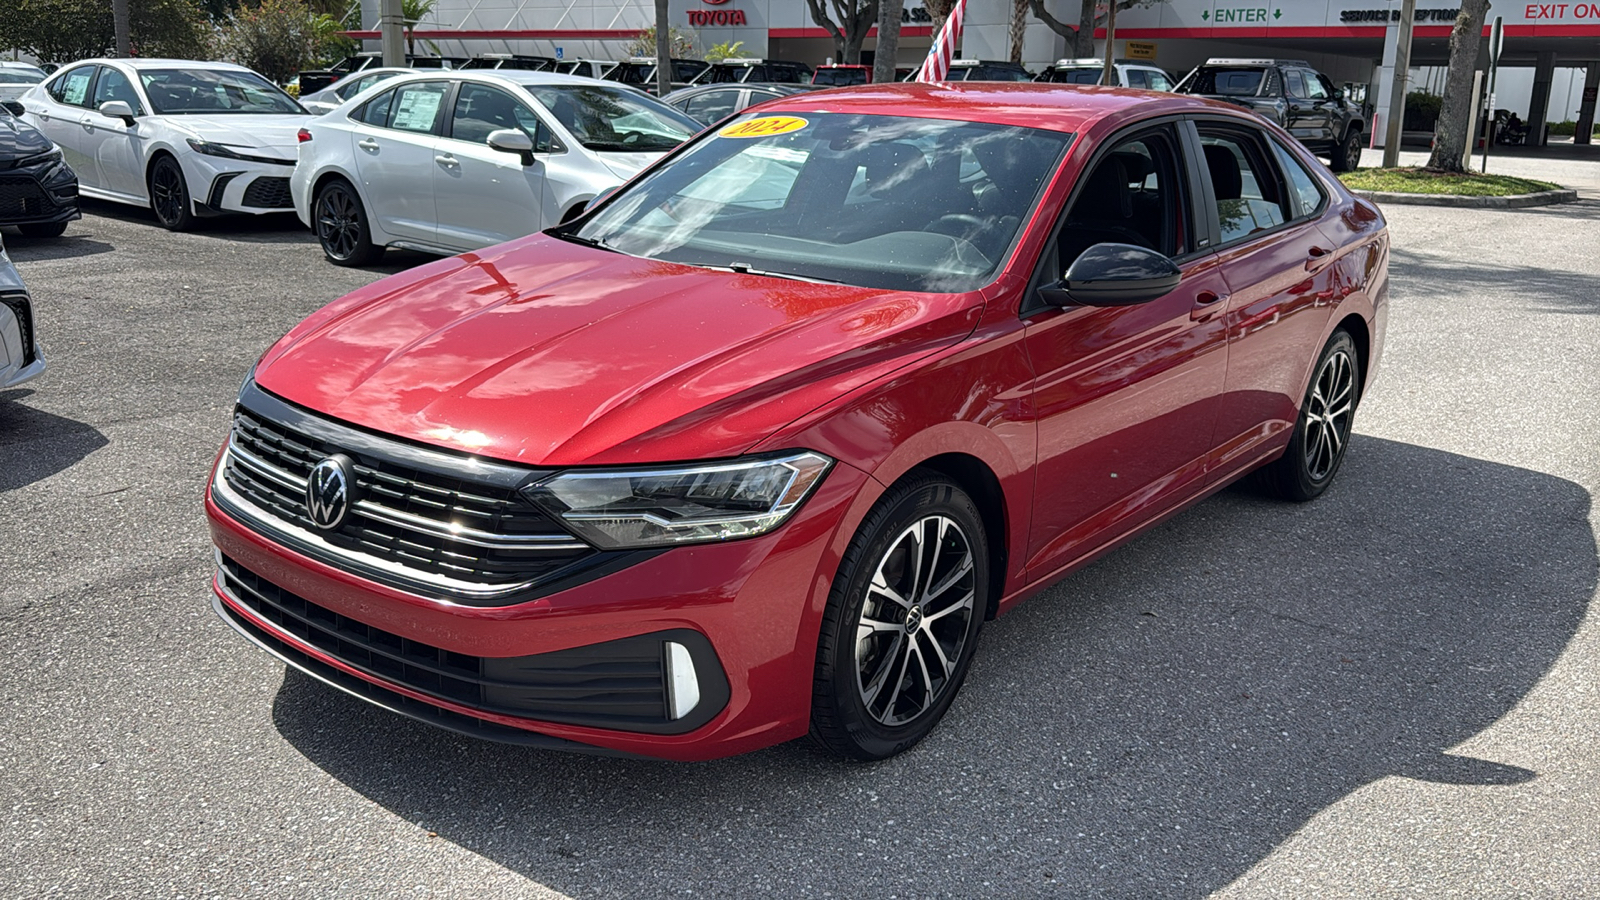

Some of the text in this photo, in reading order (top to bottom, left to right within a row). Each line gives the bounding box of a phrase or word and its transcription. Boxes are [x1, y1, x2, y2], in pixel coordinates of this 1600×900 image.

[686, 10, 746, 26] TOYOTA
[1214, 8, 1267, 23] ENTER
[1340, 8, 1461, 22] SERVICE REPTION
[1525, 4, 1569, 19] EXIT
[725, 120, 799, 135] 2024
